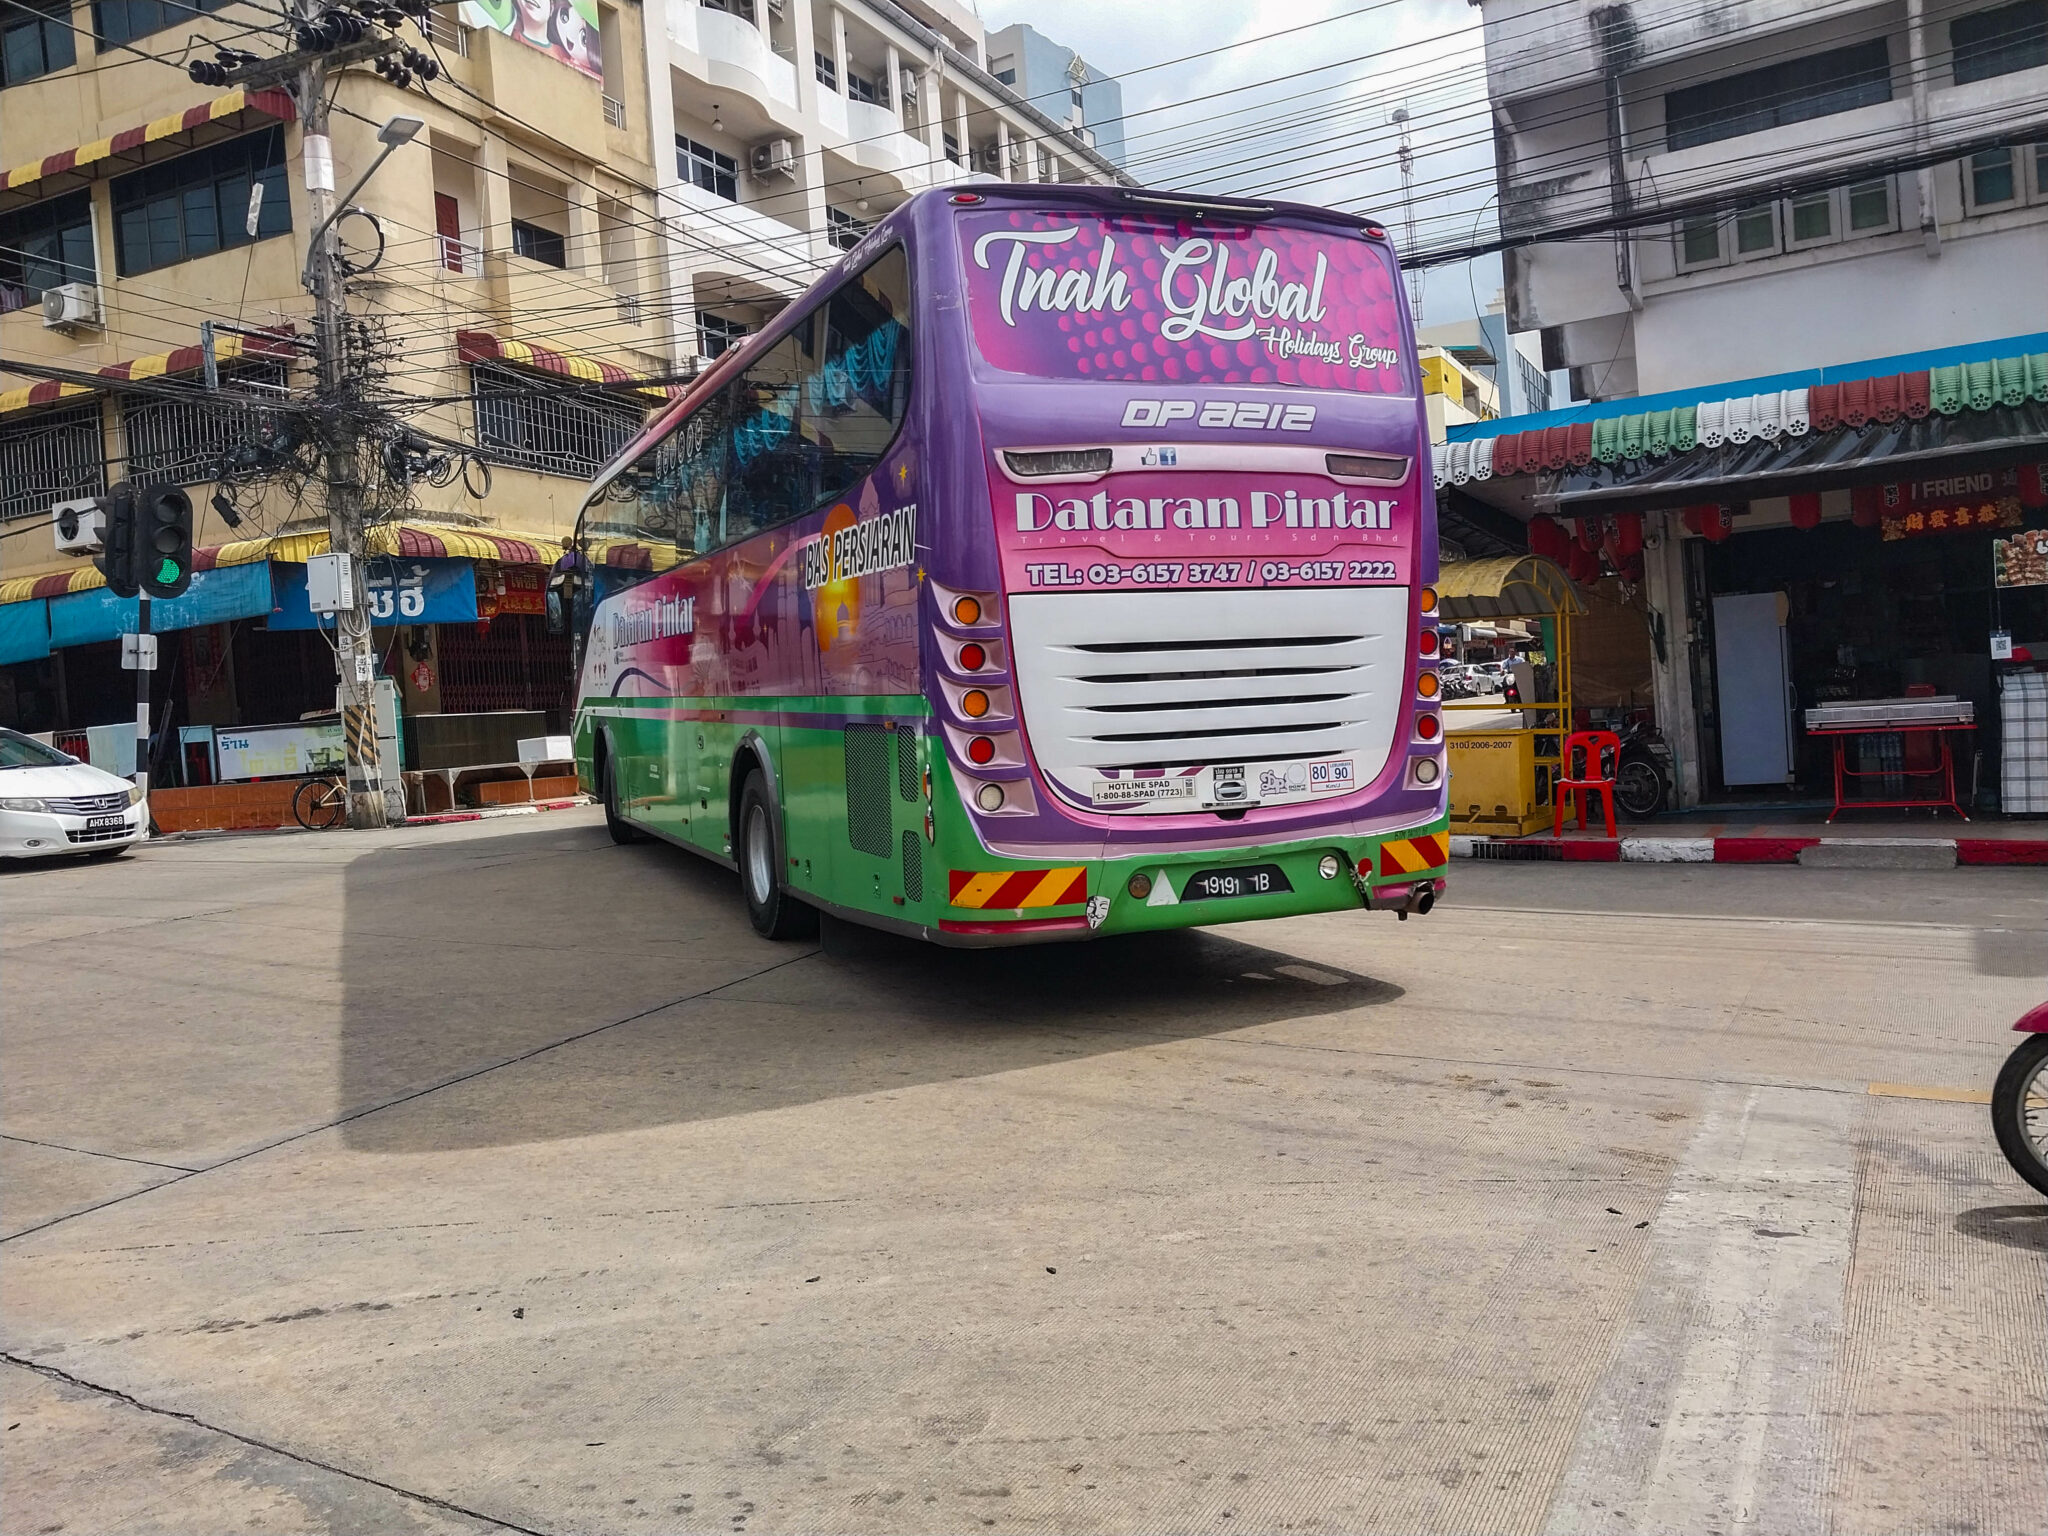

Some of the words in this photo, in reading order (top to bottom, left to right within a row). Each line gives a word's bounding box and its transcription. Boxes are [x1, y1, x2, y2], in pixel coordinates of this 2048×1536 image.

[1159, 237, 1327, 342] Global
[1256, 326, 1342, 366] Holidays
[1349, 333, 1399, 369] Group
[1922, 473, 1993, 498] FRIEND
[1015, 489, 1240, 532] Dataran
[1250, 489, 1399, 531] Pintar
[805, 534, 830, 590] BAS
[833, 504, 917, 582] PERSIARAN
[1026, 562, 1083, 586] TEL:
[1087, 562, 1183, 584] 03-6157
[1188, 561, 1243, 583] 3747
[1260, 561, 1345, 582] 03-6157
[1349, 560, 1398, 580] 2222
[613, 603, 653, 649] Dataran
[655, 592, 696, 640] Pintar
[221, 736, 250, 750] ร้าน
[1471, 741, 1512, 749] 2006-2007
[1312, 765, 1327, 780] 80
[1334, 767, 1348, 780] 90
[1096, 789, 1155, 800] 1-800-88-SPAD
[1157, 788, 1183, 798] (7723)
[1108, 781, 1146, 791] HOTLINE
[1148, 780, 1170, 789] SPAD
[1201, 876, 1240, 895] 19191
